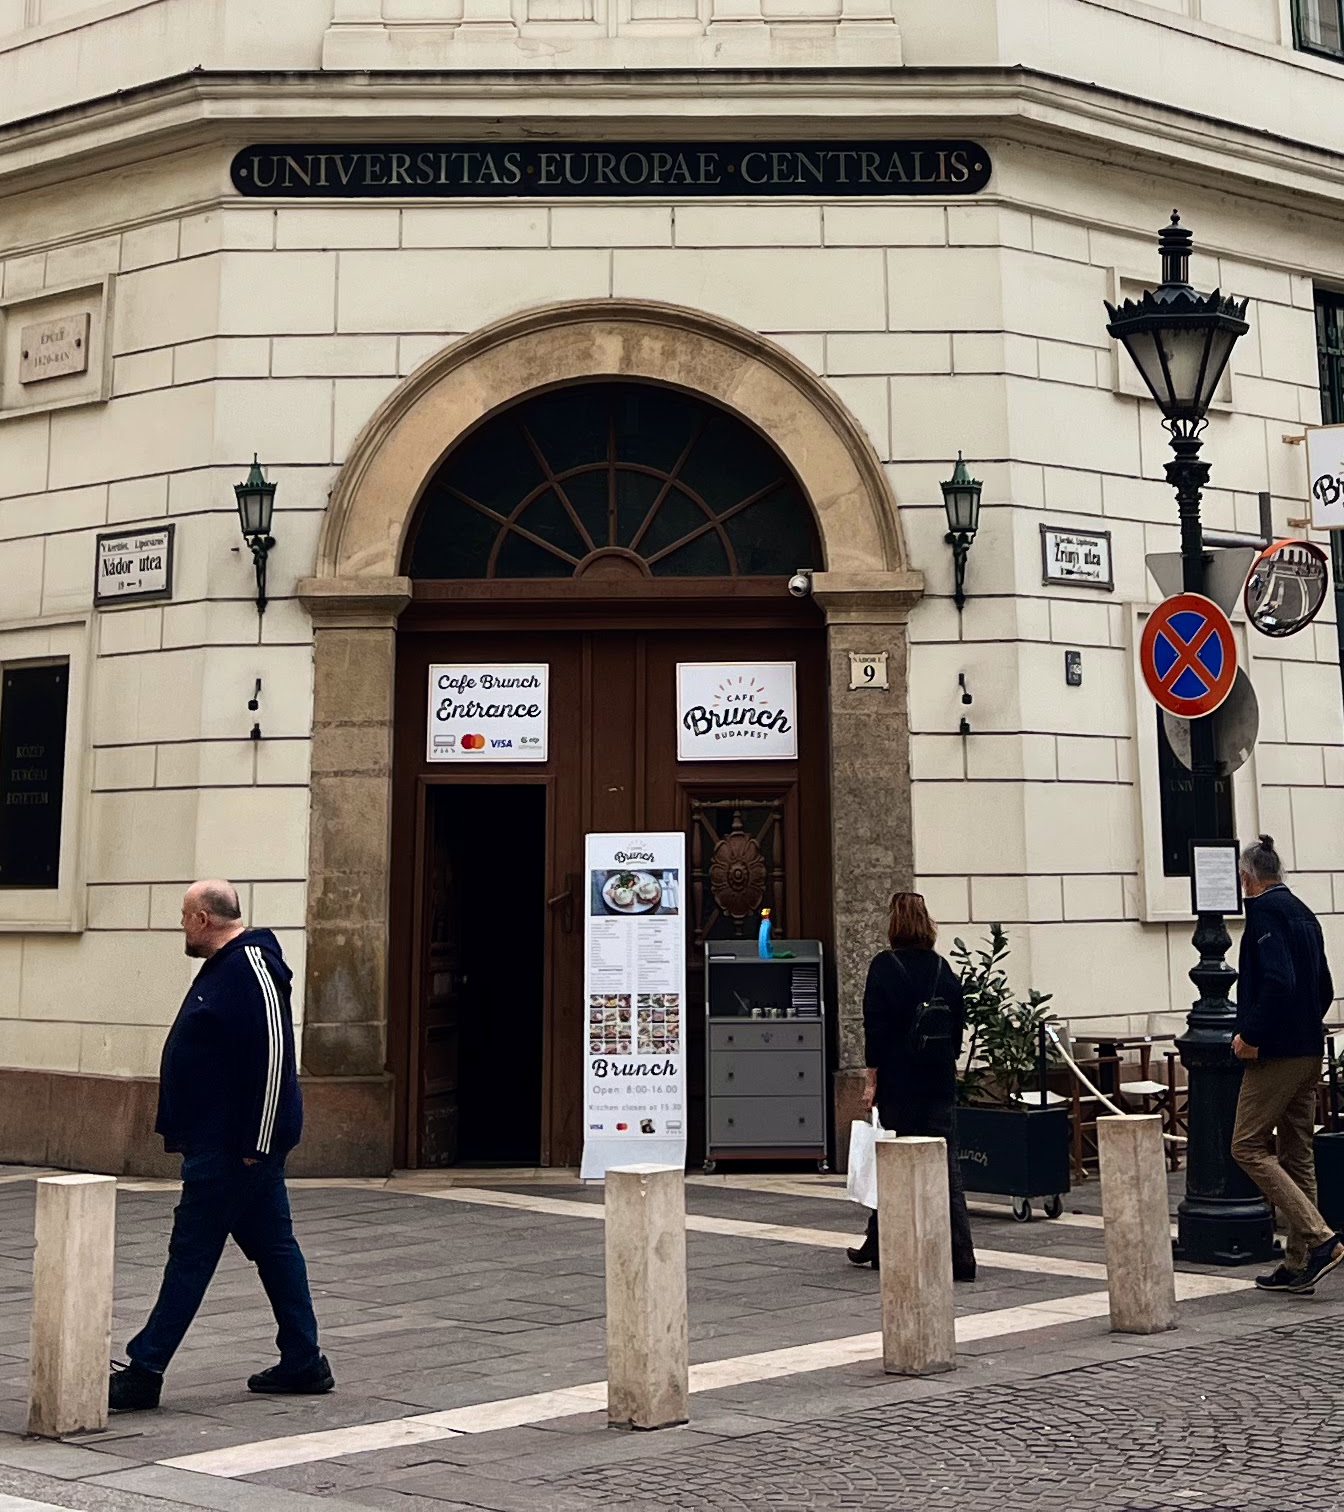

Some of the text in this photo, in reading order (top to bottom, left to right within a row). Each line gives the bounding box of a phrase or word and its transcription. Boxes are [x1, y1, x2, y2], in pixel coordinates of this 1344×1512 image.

[250, 150, 969, 187] UNIVERSITAS EUROPAE CENTRALIS
[102, 555, 162, 577] Nádor utca
[438, 674, 541, 695] Cafe Brunch
[863, 665, 875, 684] 9
[726, 694, 754, 702] CAFE
[436, 697, 541, 722] Entrance
[683, 705, 791, 737] Brunch
[490, 739, 513, 749] VISA
[714, 730, 769, 740] BUDAPEST
[614, 851, 655, 864] Brunch
[591, 1058, 678, 1078] Brunch
